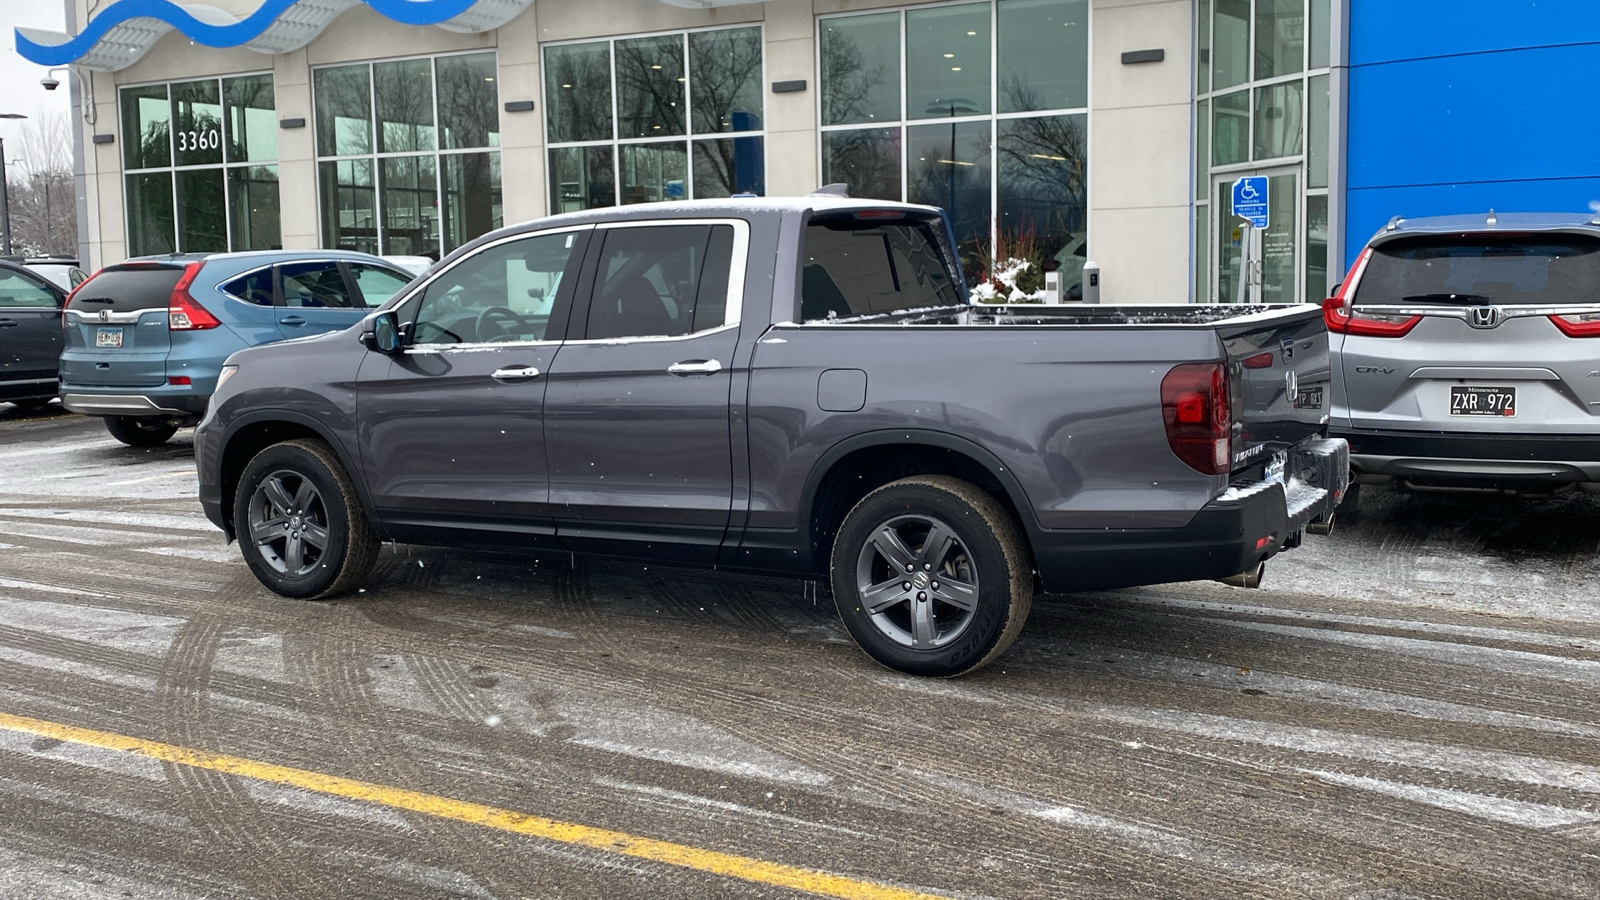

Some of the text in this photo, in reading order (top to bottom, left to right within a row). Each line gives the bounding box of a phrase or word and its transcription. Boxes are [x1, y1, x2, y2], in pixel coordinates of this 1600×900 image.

[178, 130, 218, 151] 3360
[1355, 365, 1396, 375] CR-V
[1452, 393, 1513, 410] ZXR 972
